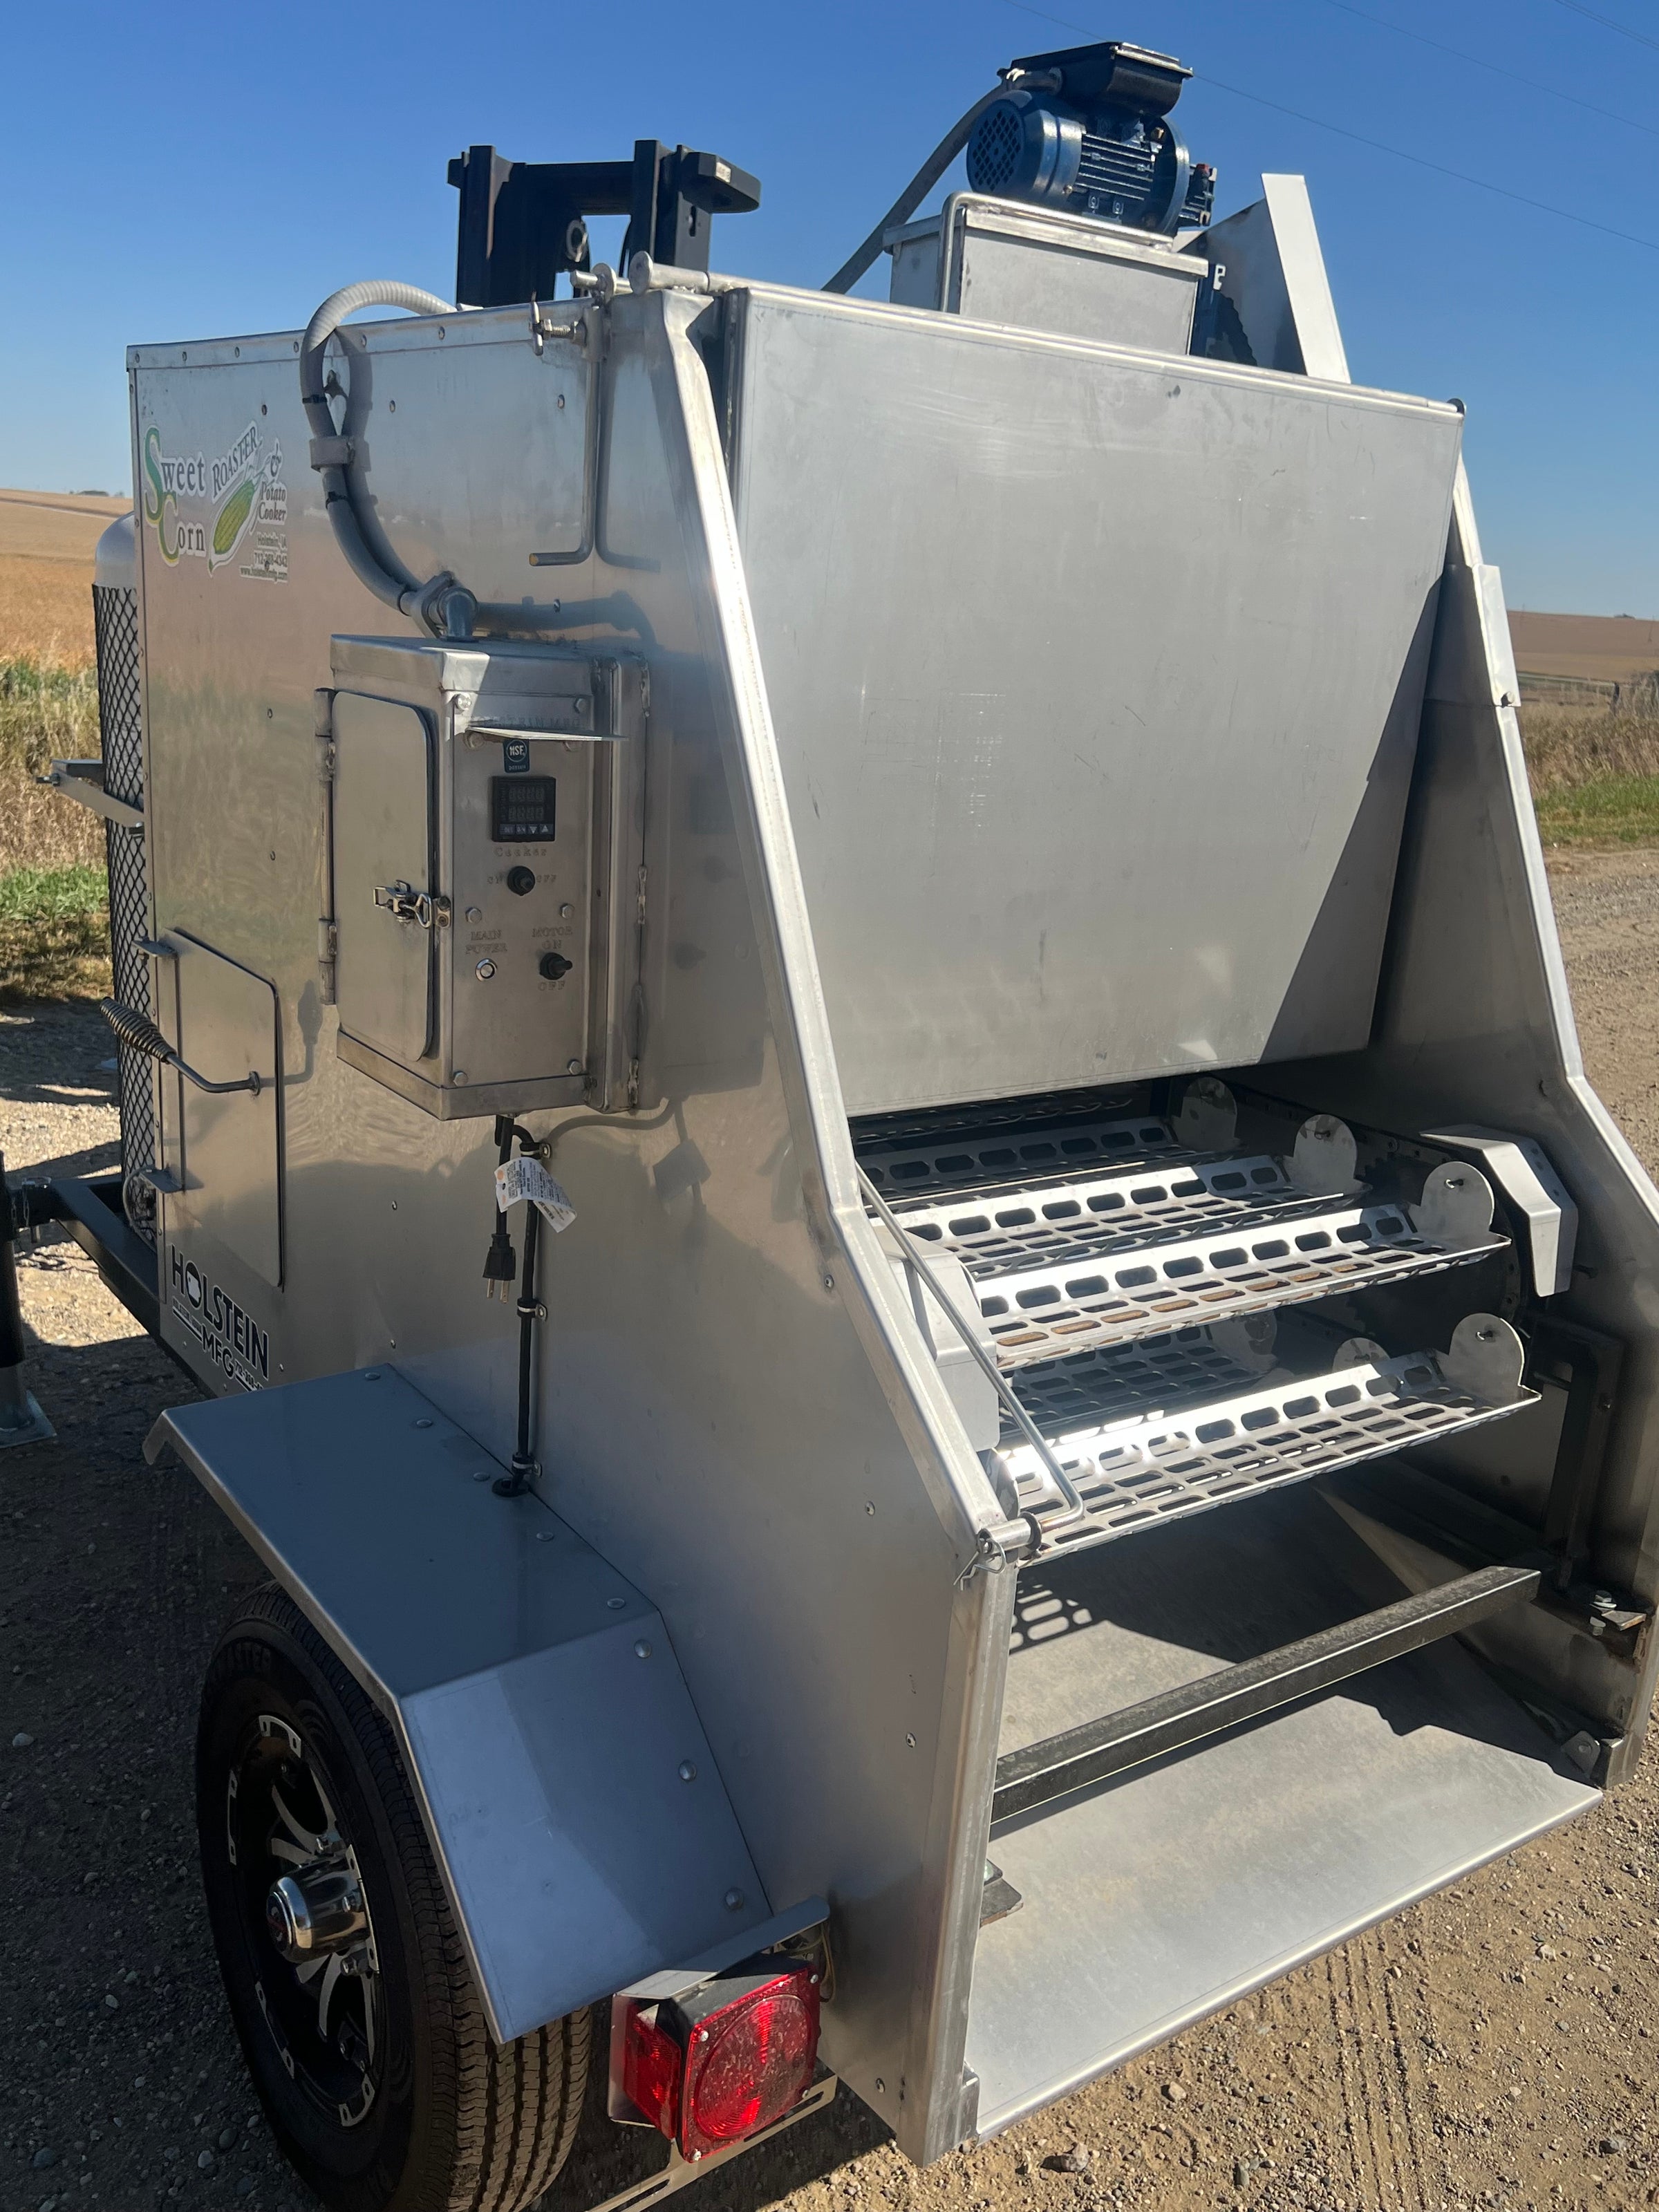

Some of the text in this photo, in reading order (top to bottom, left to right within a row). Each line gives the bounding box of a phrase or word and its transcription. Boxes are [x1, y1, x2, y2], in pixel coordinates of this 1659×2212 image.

[212, 427, 257, 497] ROASTER
[144, 427, 205, 525] Sweet
[261, 481, 286, 501] Potato
[259, 502, 286, 521] Cooker
[159, 490, 205, 563] Corn
[509, 745, 524, 756] NSF
[470, 930, 503, 941] MAIN
[532, 926, 572, 937] MOTOR
[465, 943, 508, 955] POWER
[542, 939, 563, 950] ON
[538, 981, 565, 992] OFF
[172, 1244, 268, 1380] HOLSTEIN
[203, 1324, 234, 1379] MFG
